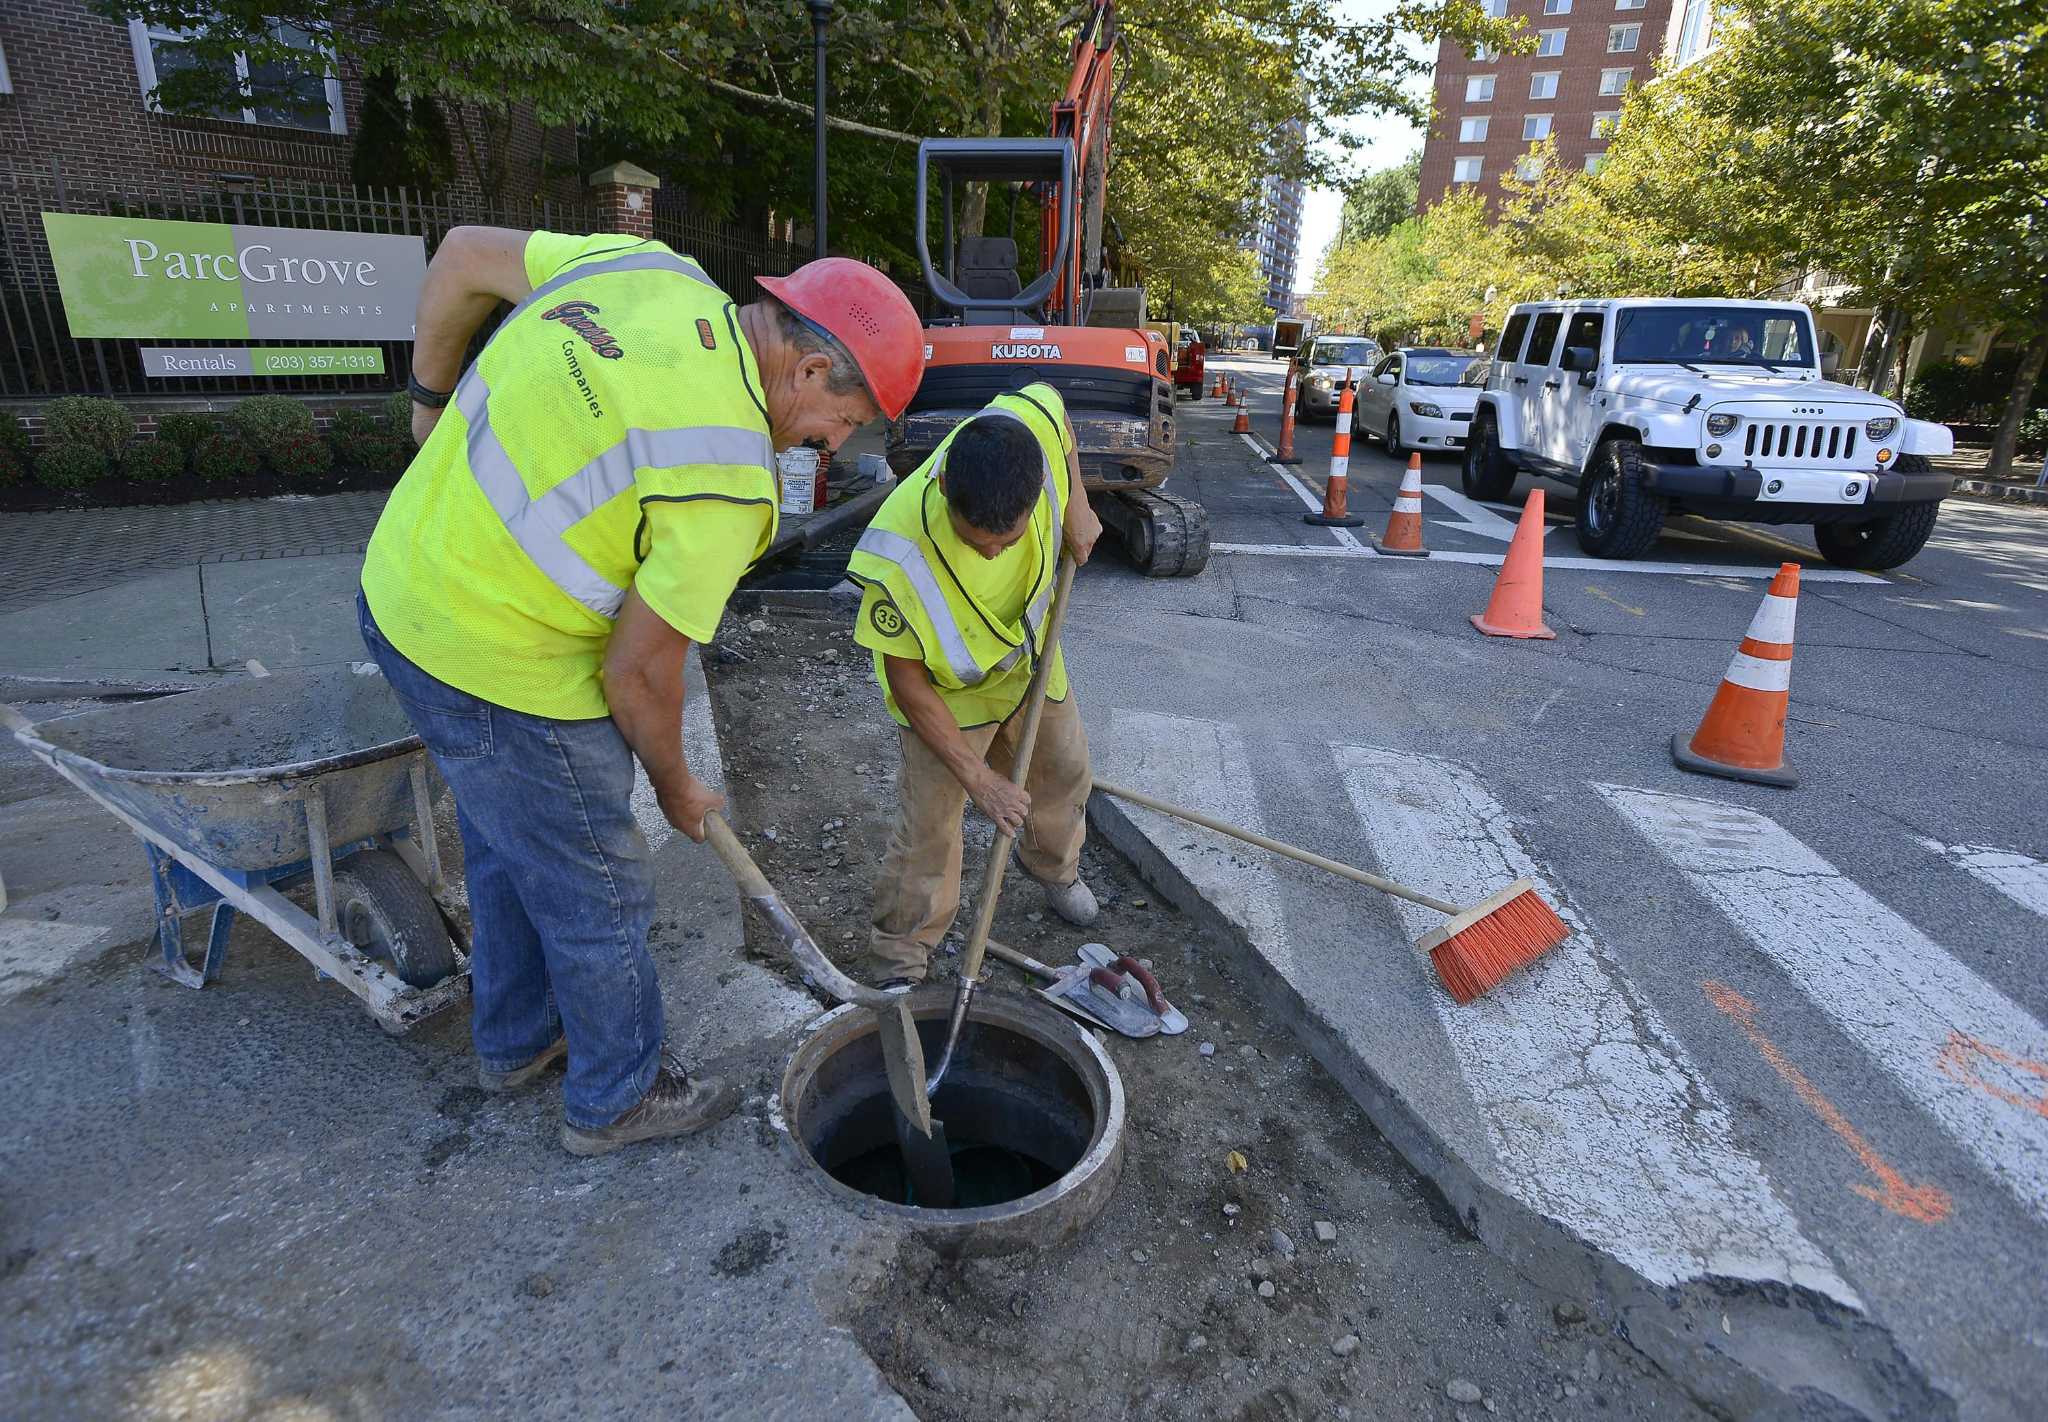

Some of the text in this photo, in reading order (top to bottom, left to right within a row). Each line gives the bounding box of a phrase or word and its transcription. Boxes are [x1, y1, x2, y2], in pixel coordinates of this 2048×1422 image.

[124, 239, 379, 287] ParcGrove
[209, 302, 383, 315] APARTMENTS
[991, 344, 1062, 359] KUBOTA
[162, 354, 376, 371] Rentals (203) 357-1313
[562, 340, 603, 418] Companies
[877, 609, 898, 628] 35
